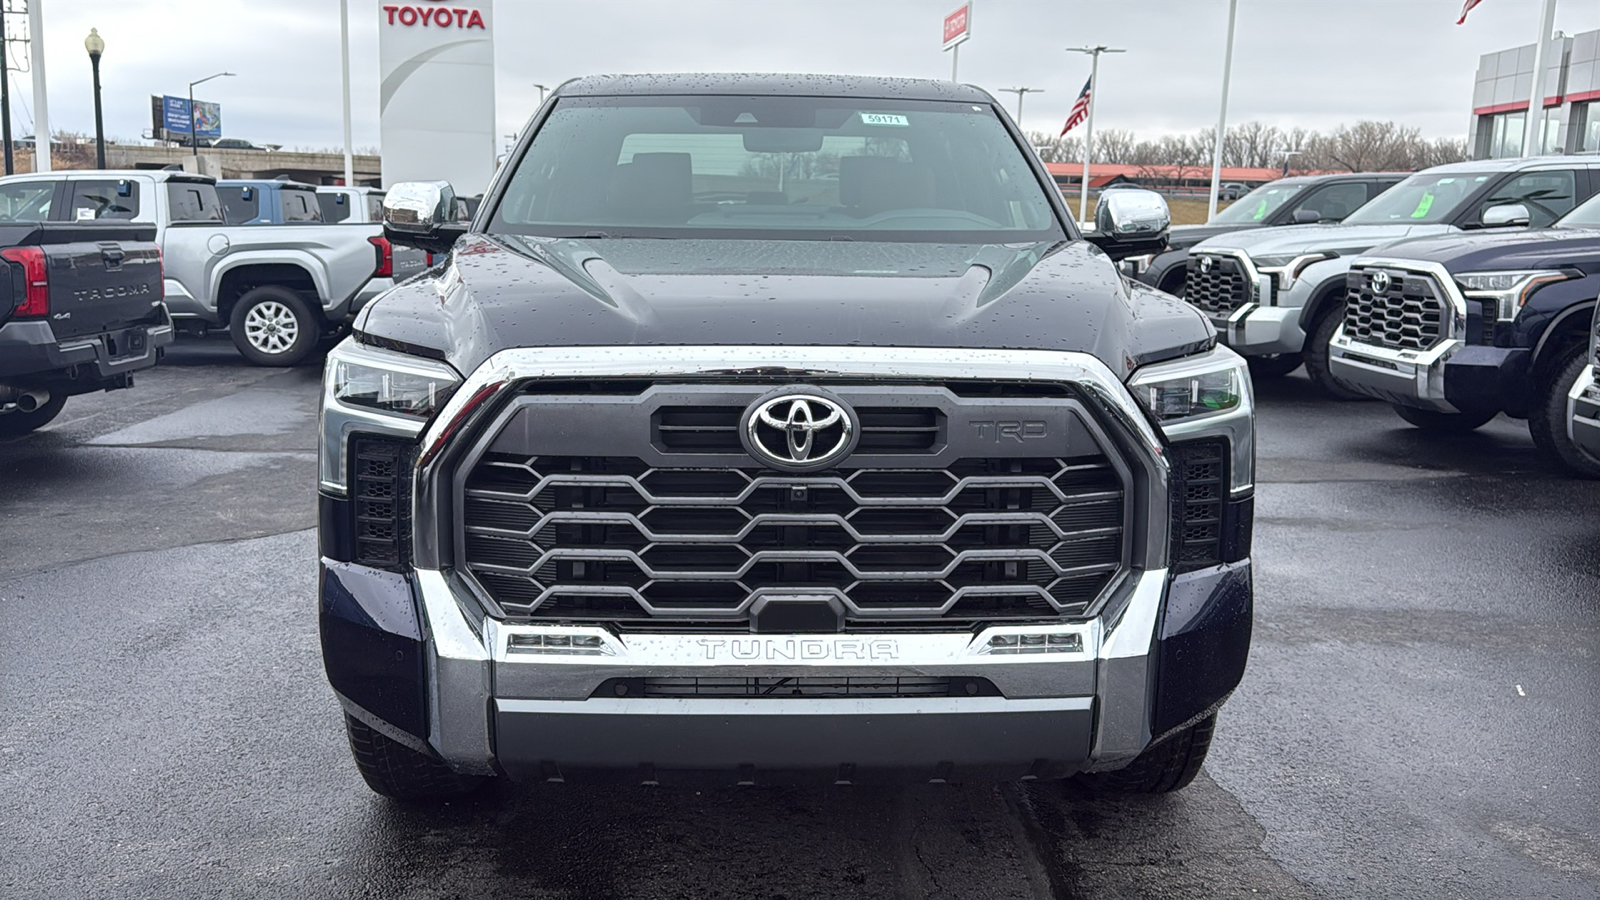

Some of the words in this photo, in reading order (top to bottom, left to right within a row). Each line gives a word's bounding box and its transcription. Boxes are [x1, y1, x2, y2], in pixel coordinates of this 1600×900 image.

[383, 6, 485, 29] TOYOTA
[868, 115, 900, 123] 59171
[74, 283, 150, 301] TACOMA
[969, 420, 1047, 443] TRD
[696, 640, 899, 659] TUNDRA
